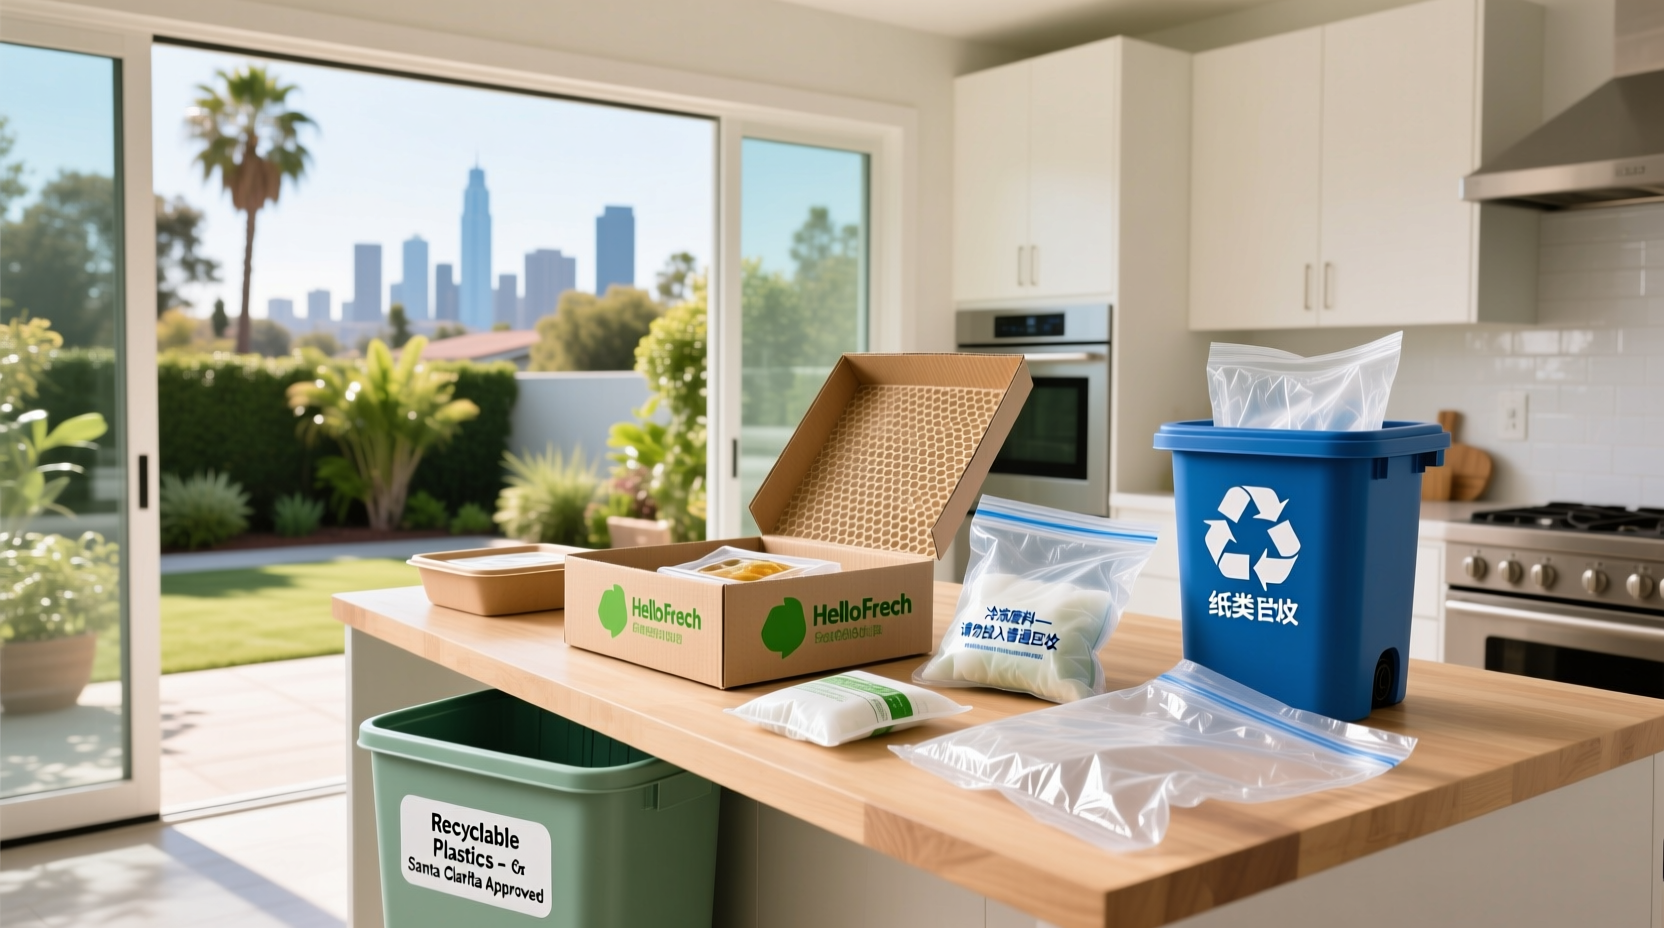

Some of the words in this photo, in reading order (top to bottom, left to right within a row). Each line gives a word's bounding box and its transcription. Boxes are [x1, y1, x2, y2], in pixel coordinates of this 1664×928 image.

[632, 596, 702, 631] HelloFrech
[813, 593, 912, 626] HelloFrech
[431, 812, 520, 849] Recyclable
[433, 838, 494, 869] Plastics
[407, 856, 441, 878] Santa
[485, 876, 544, 904] Approved
